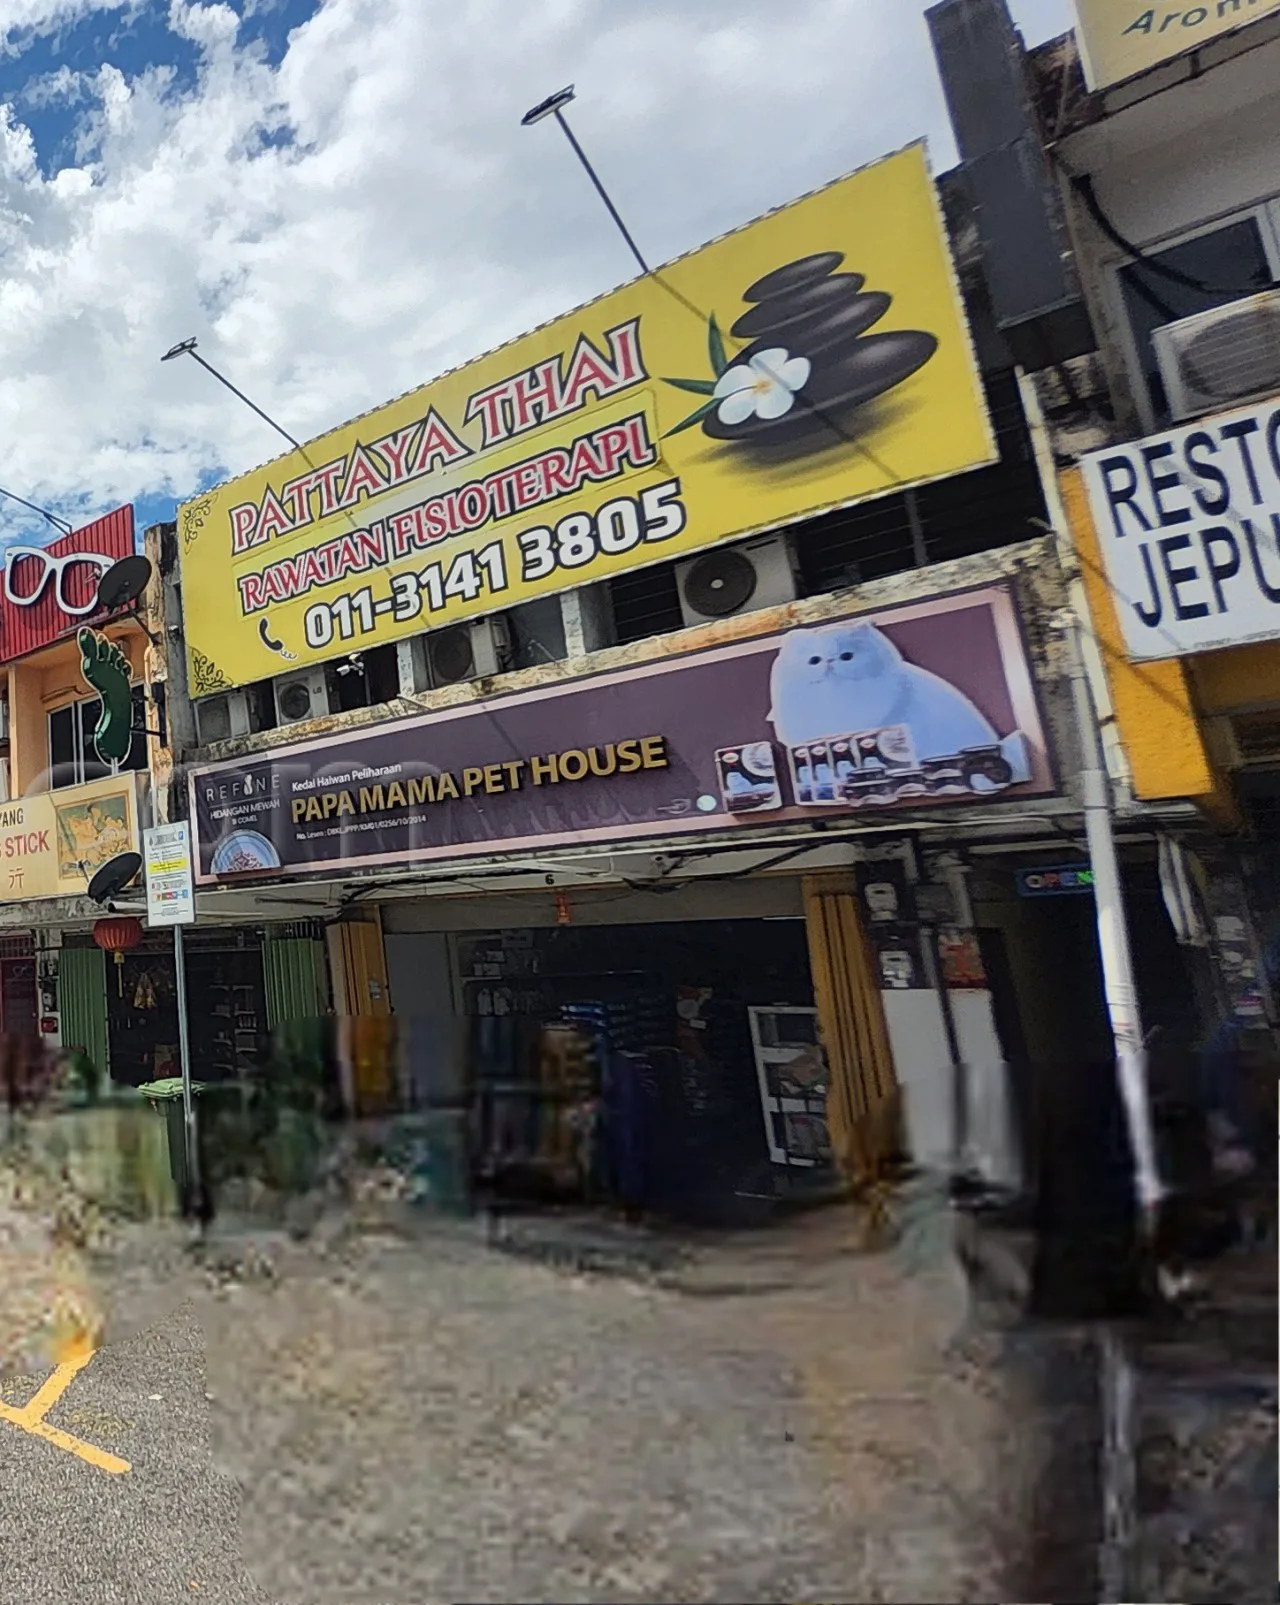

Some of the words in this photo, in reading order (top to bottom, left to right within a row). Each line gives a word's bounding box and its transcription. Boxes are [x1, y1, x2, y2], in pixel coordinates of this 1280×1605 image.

[229, 405, 475, 555] PATTAYA
[463, 316, 650, 450] THAI
[238, 519, 388, 615] RAWATAN
[390, 411, 656, 559] FISIOTERAPI
[305, 540, 508, 648] 011-3141
[517, 476, 686, 581] 3805
[291, 790, 354, 824] PAPA
[359, 772, 460, 814] MAMA
[463, 760, 524, 796] PET
[530, 735, 667, 786] HOUSE
[292, 779, 315, 792] Kedai
[317, 773, 351, 789] Haiwan
[352, 763, 402, 780] Peliharaan
[210, 804, 250, 820] HIDANGAN
[250, 799, 280, 814] MEWAH
[5, 830, 50, 858] STICK
[545, 874, 554, 885] 6
